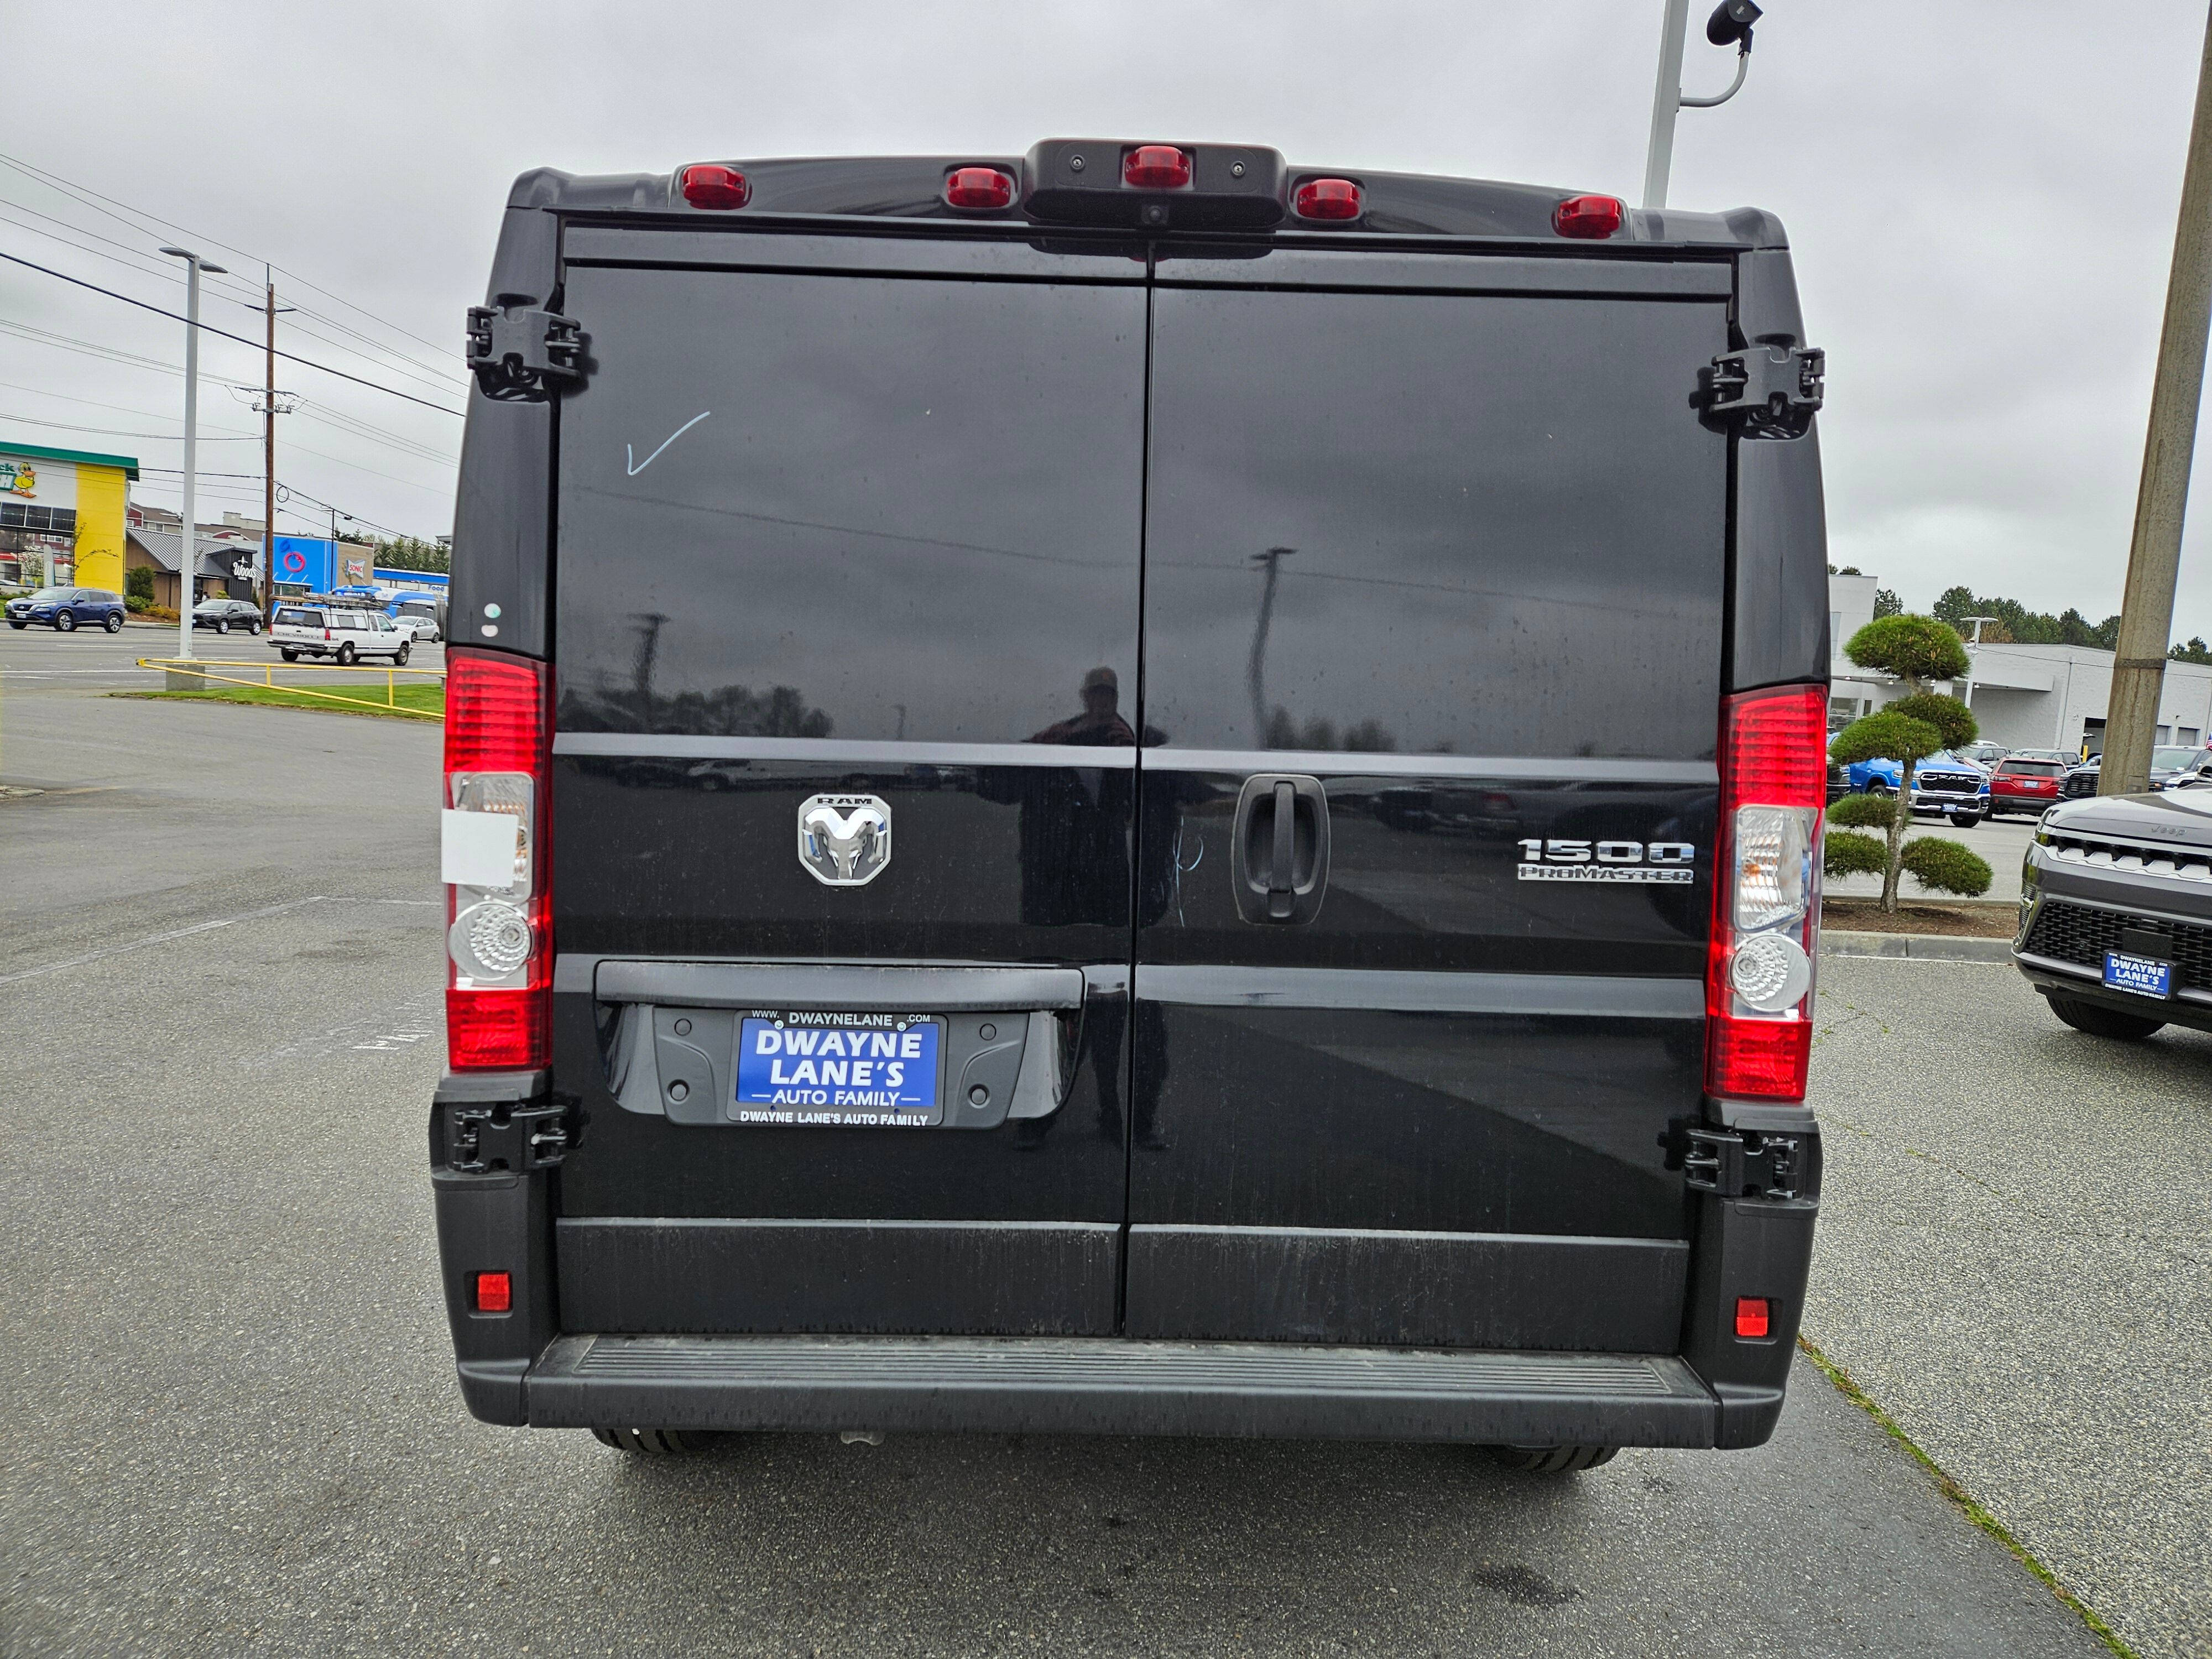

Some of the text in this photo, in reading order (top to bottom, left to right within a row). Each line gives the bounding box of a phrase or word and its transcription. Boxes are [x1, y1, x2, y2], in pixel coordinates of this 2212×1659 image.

[233, 561, 256, 578] Woods
[349, 564, 363, 573] SONIC
[2151, 825, 2187, 837] Jeep
[1517, 838, 1695, 864] 1500
[2111, 958, 2166, 977] DWAYNE
[2120, 955, 2155, 966] DWAYNELANE
[2115, 968, 2159, 985] LANE'S
[2136, 982, 2158, 991] FAMILY
[789, 1012, 893, 1026] DWAYNELANE
[906, 1014, 930, 1023] .COM
[755, 1030, 922, 1058] DWAYNE
[770, 1059, 904, 1087] LANE'S
[772, 1089, 900, 1107] AUTO FAMILY
[740, 1111, 928, 1126] DWAYNE LANE'S AUTO FAMILY
